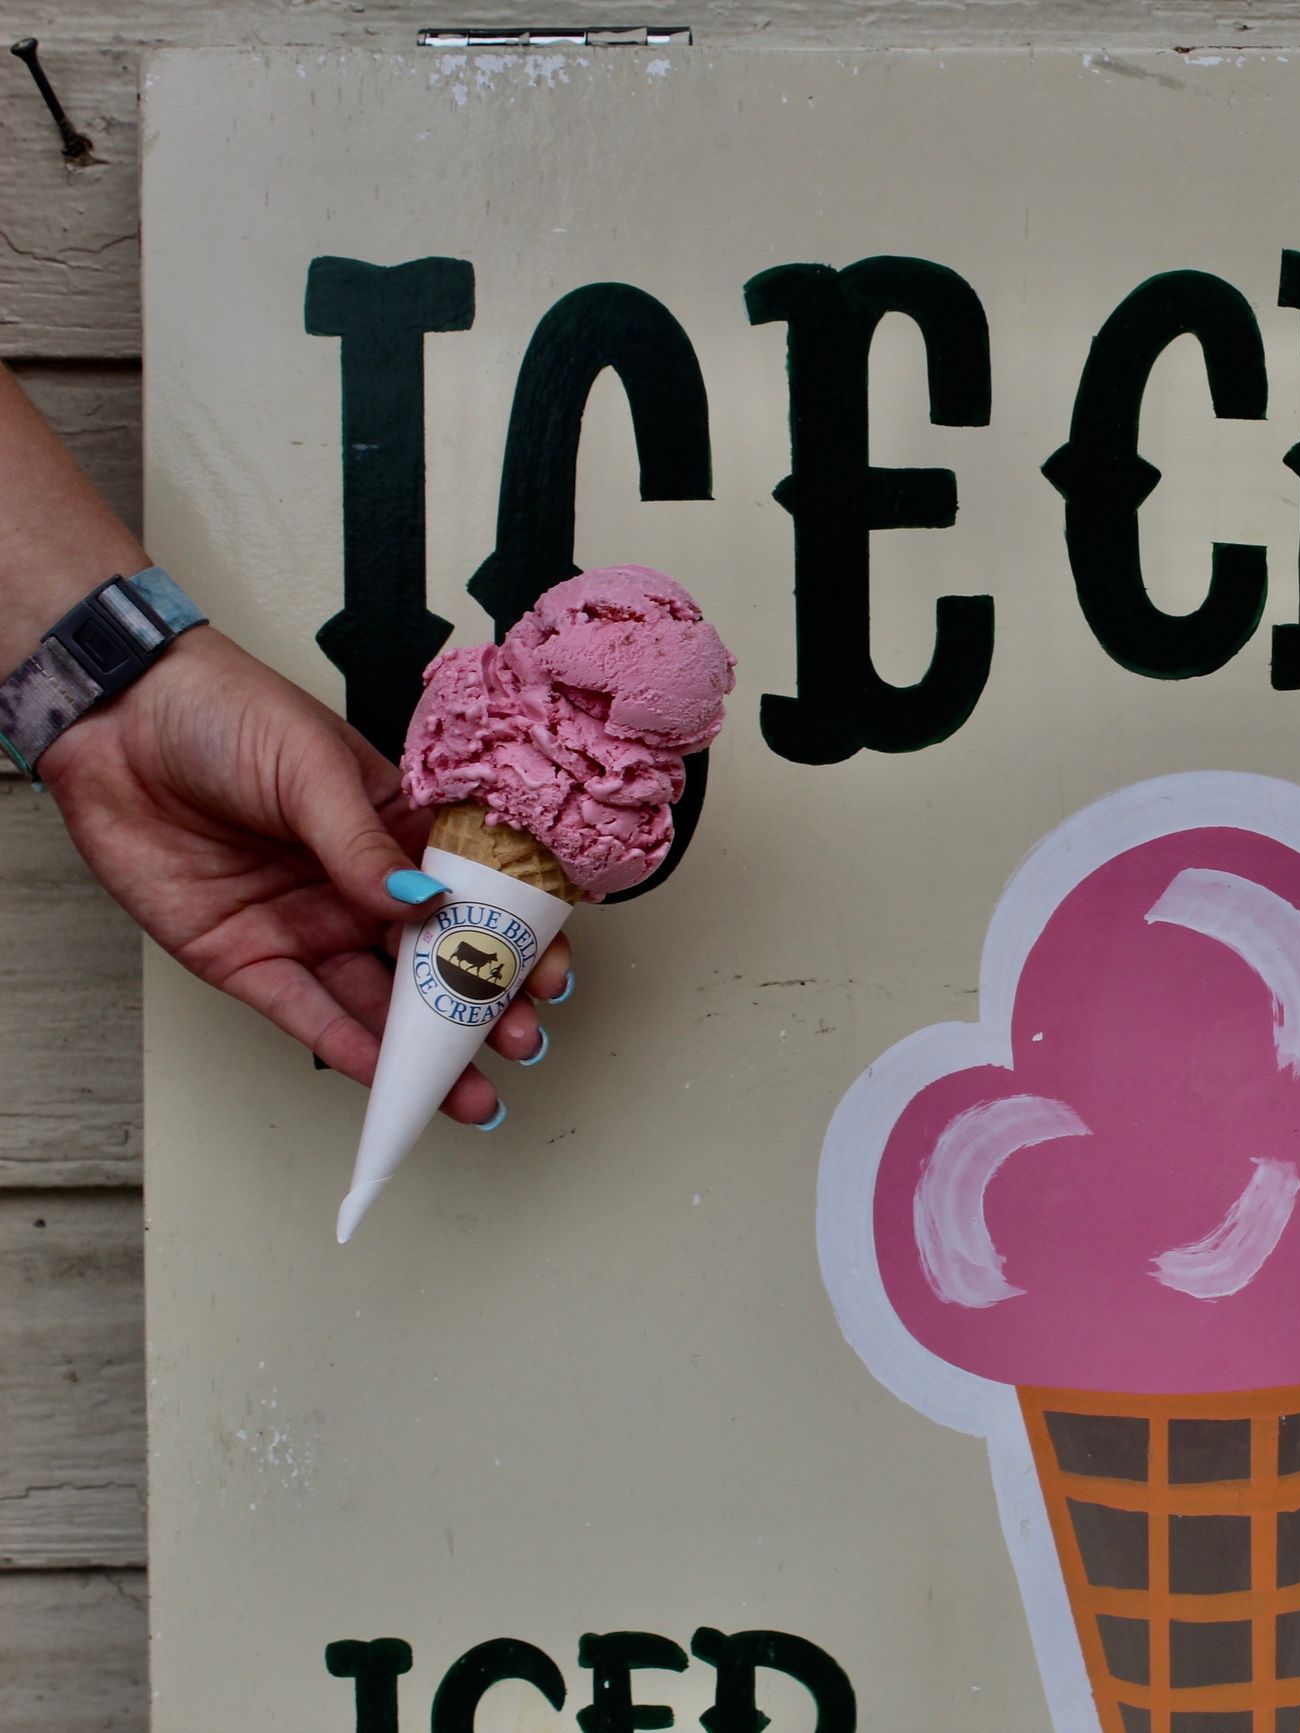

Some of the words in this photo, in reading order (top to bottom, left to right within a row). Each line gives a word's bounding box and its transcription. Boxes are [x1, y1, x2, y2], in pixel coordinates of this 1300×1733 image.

[304, 255, 995, 908] ICE
[435, 905, 502, 931] BLUE
[502, 918, 536, 969] BELL
[415, 951, 438, 995] ICE
